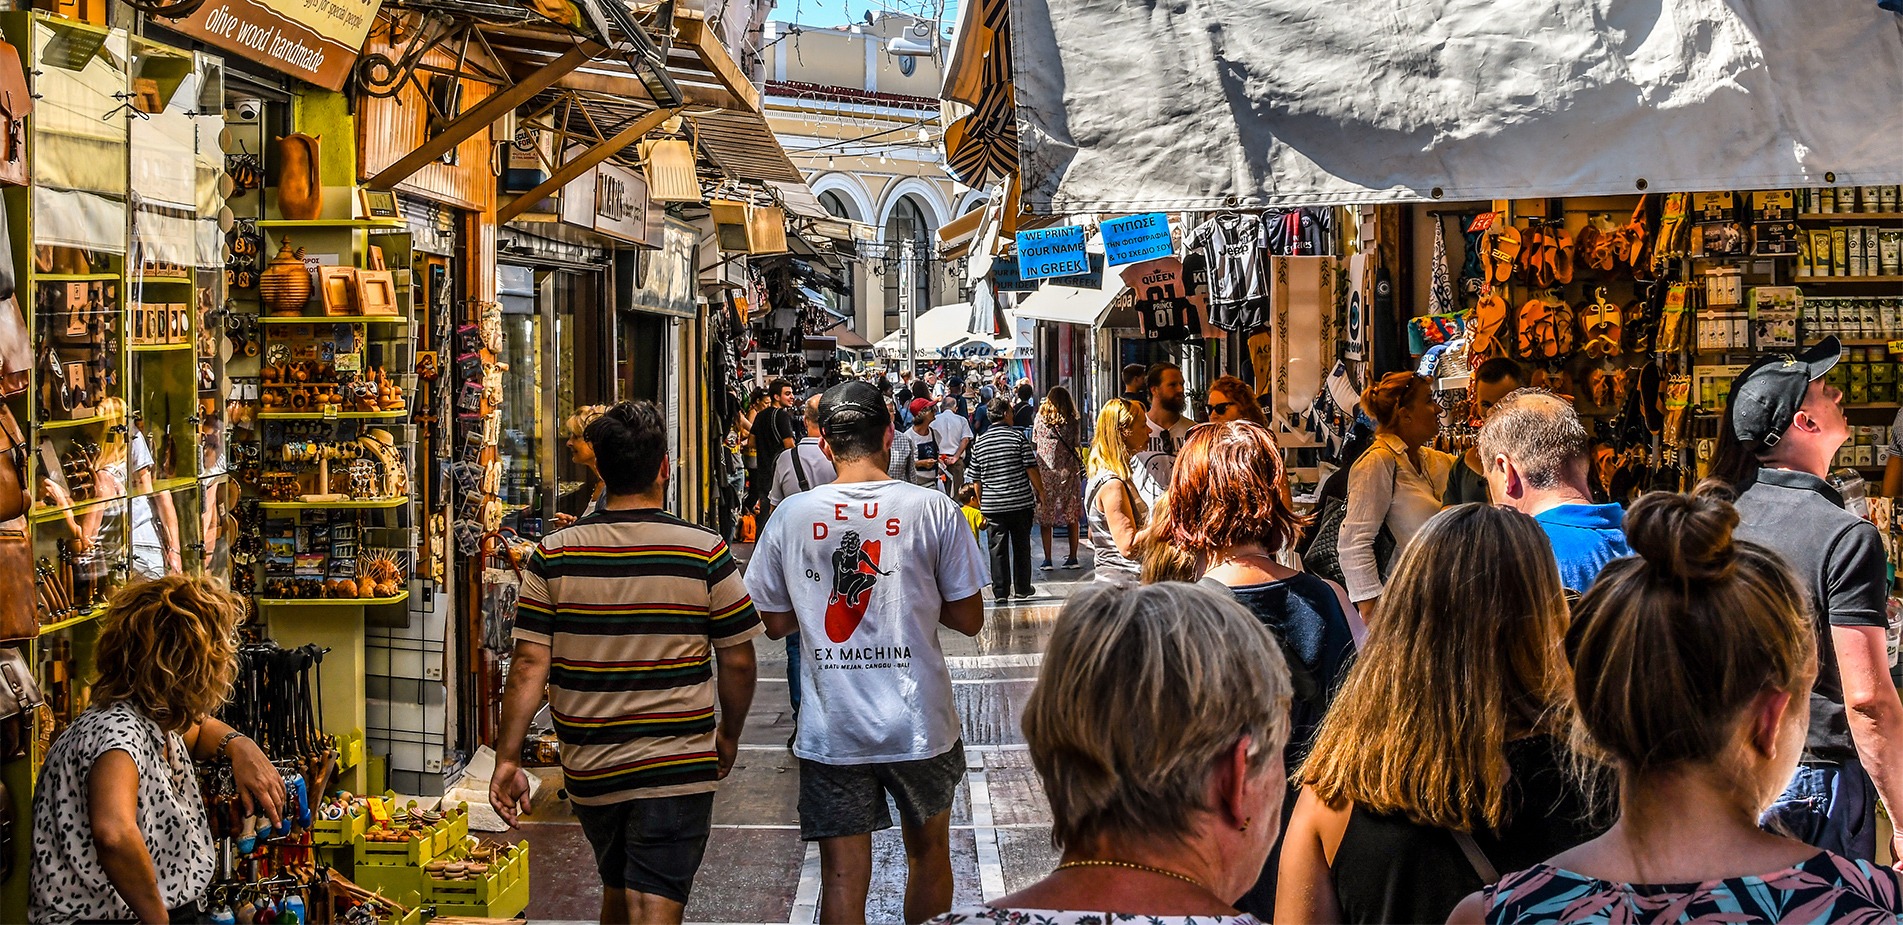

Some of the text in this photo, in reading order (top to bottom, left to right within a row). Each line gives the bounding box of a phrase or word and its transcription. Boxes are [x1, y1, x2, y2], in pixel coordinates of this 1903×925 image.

[316, 0, 330, 12] for
[328, 4, 348, 18] special
[342, 12, 363, 30] people
[205, 5, 326, 74] olive wood handmade
[1112, 217, 1156, 234] ΤΥΠΩΣΕ
[1025, 228, 1075, 241] WE PRINT
[1106, 232, 1168, 249] ΤΗΝ ΦΩΤΟΓΡΑΦΙΑ
[1020, 243, 1084, 257] YOUR NAME
[1116, 252, 1128, 260] ΤΟ
[1129, 246, 1155, 258] ΣΧΕΔΙΟ
[1156, 242, 1172, 252] ΣΟΥ
[1027, 260, 1083, 276] IN GREEK
[1064, 278, 1097, 287] GREEK
[1142, 272, 1174, 284] QUEEN
[1152, 302, 1173, 310] PRINCE
[1155, 308, 1174, 327] 01
[813, 502, 900, 540] DEUS
[805, 568, 820, 582] 08
[814, 646, 912, 660] EX MACHINA
